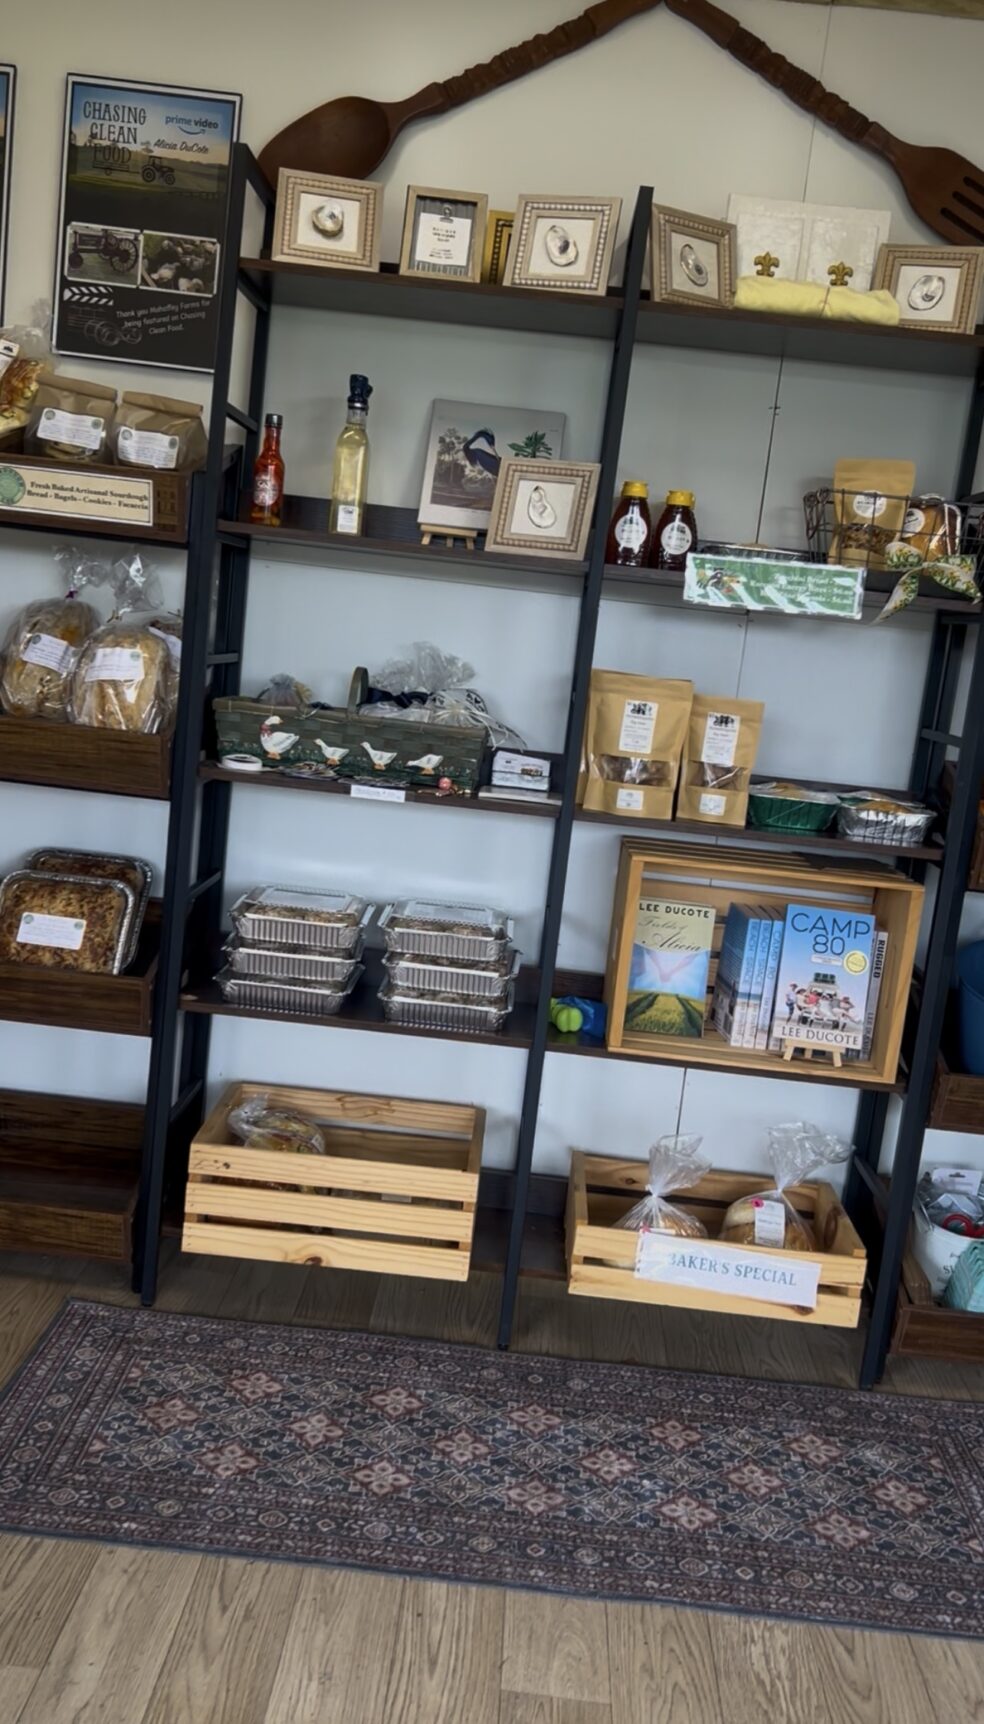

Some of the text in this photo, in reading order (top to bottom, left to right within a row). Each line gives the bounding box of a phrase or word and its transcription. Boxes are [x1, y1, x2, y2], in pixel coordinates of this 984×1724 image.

[83, 101, 146, 125] CHASING
[165, 115, 219, 130] prime video
[90, 122, 137, 144] CLEAN
[94, 143, 131, 163] FOOD
[116, 310, 135, 318] Thank
[136, 309, 148, 318] you
[124, 320, 142, 328] being
[143, 315, 170, 324] featured
[180, 311, 206, 320] Chasing
[149, 327, 166, 335] Clean
[27, 490, 48, 498] Bread
[54, 492, 77, 502] Bagels
[83, 496, 112, 506] Cookies
[30, 481, 149, 502] Fresh Baked Artisanal Sourdough
[639, 902, 710, 919] LEE DUCOTE
[790, 912, 871, 939] CAMP
[812, 933, 845, 956] 80
[873, 939, 885, 978] RUGGED
[781, 1025, 859, 1046] LEE DUCOTE
[734, 1264, 797, 1286] SPECIAL
